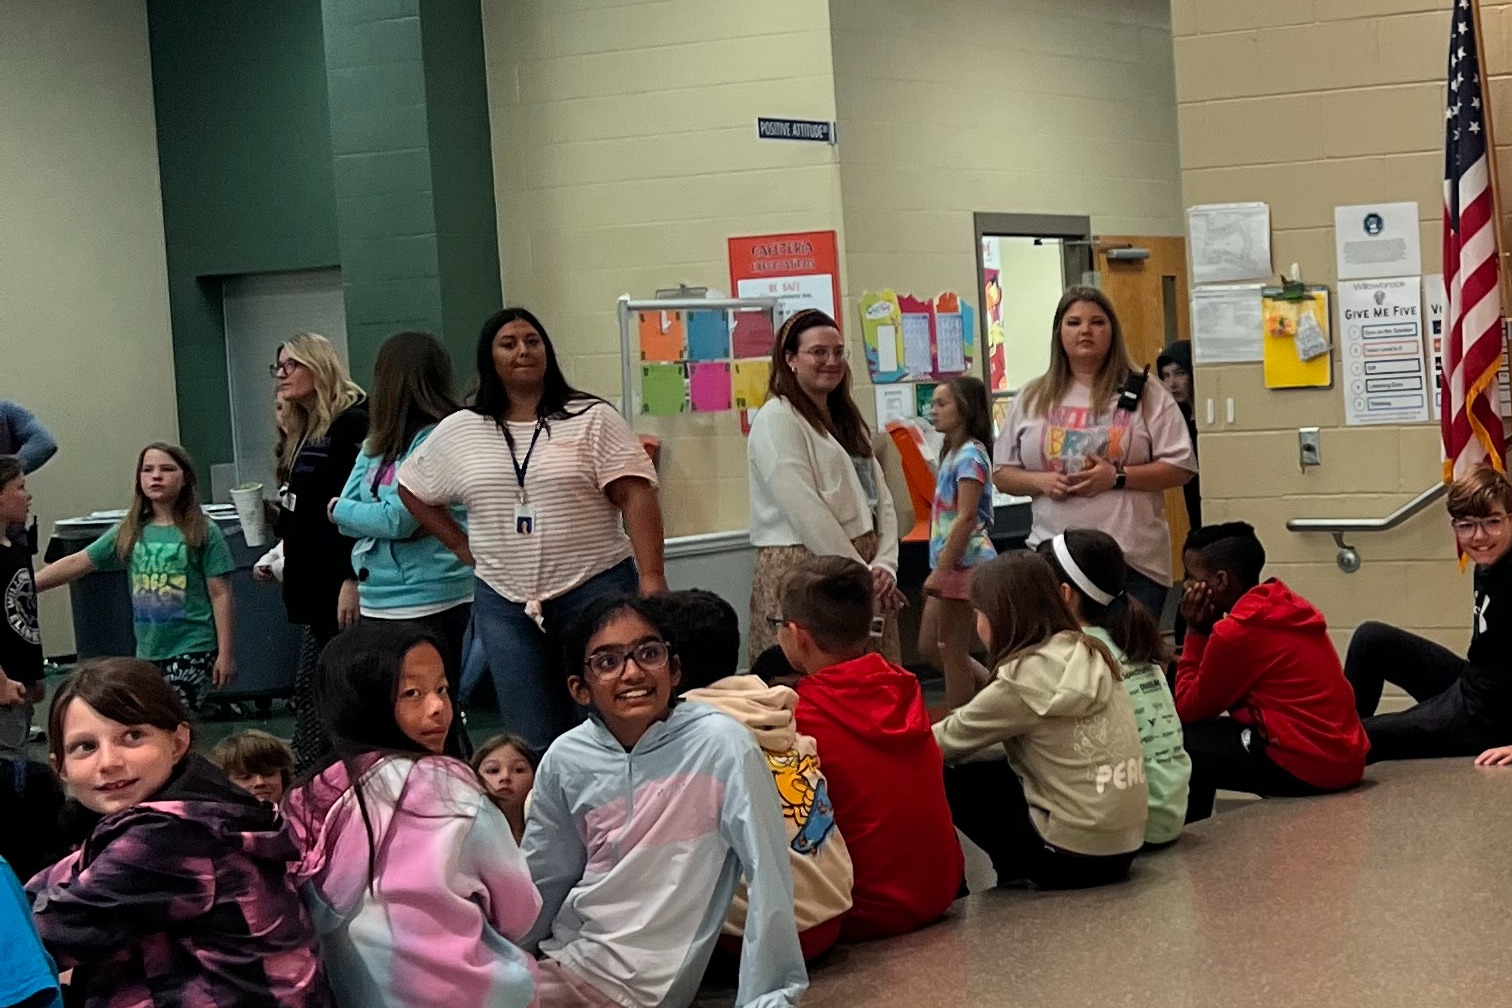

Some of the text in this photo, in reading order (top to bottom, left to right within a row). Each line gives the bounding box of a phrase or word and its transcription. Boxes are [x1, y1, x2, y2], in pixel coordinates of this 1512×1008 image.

[760, 121, 790, 136] POSITIVE
[792, 123, 823, 138] ATTITUDE
[1345, 305, 1417, 320] GIVE ME FIVE
